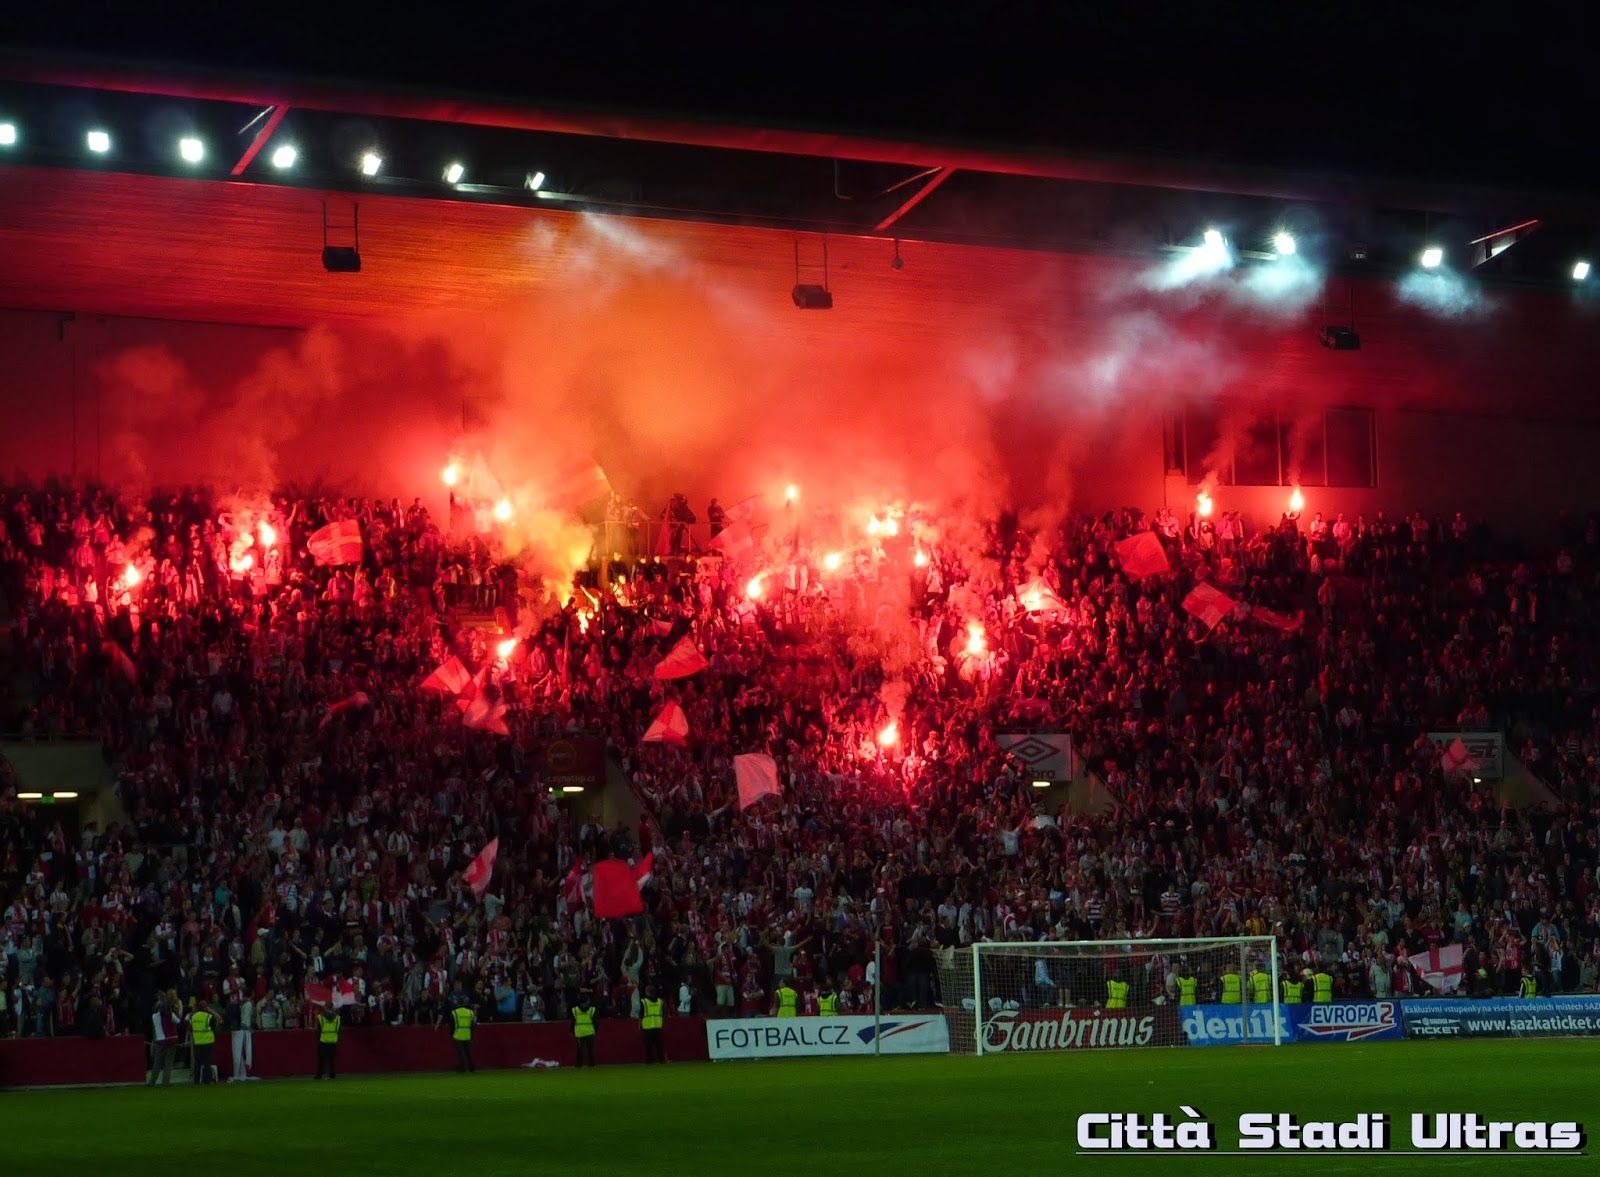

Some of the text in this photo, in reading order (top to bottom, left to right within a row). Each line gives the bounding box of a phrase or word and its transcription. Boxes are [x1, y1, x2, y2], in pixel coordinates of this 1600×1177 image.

[1444, 1004, 1481, 1014] vstupenky
[1493, 1003, 1514, 1011] všech
[974, 1009, 1155, 1052] Gambrinus
[1182, 1008, 1290, 1040] deník
[1411, 1026, 1460, 1035] TICKET
[715, 1025, 850, 1049] FOTBAL.CZ
